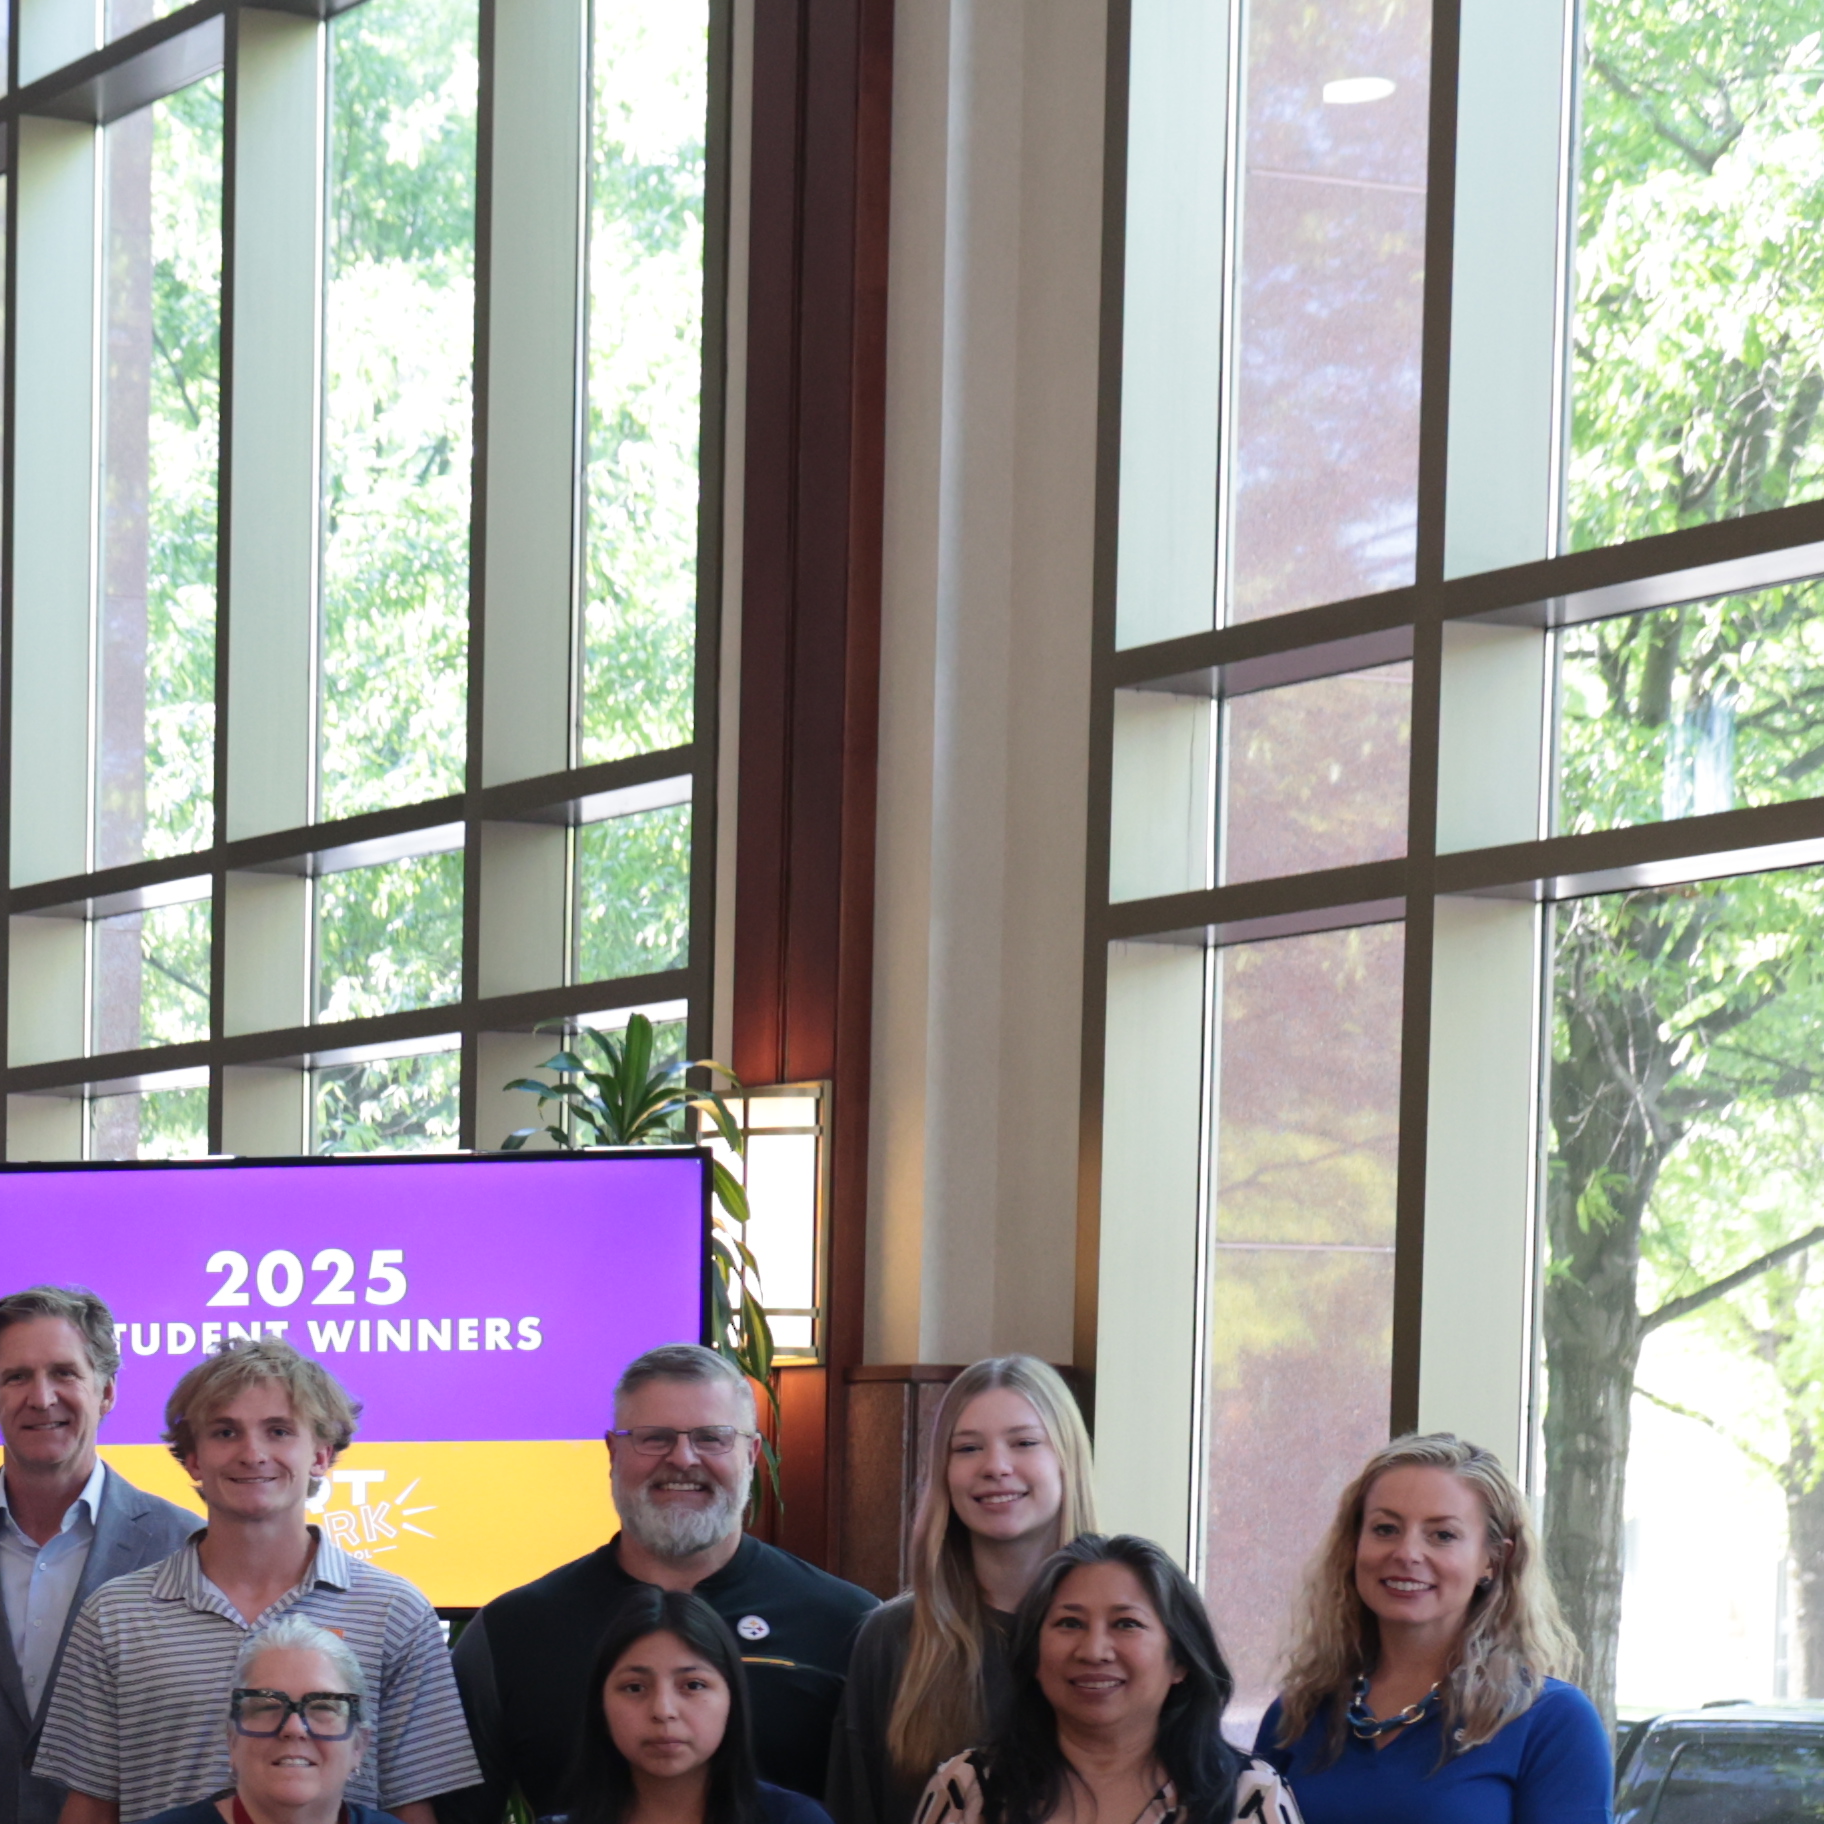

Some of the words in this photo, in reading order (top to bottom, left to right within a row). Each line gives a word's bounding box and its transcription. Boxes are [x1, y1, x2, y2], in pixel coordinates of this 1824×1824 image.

[205, 1248, 408, 1308] 2025
[113, 1321, 289, 1357] TUDENT
[307, 1316, 543, 1353] WINNERS
